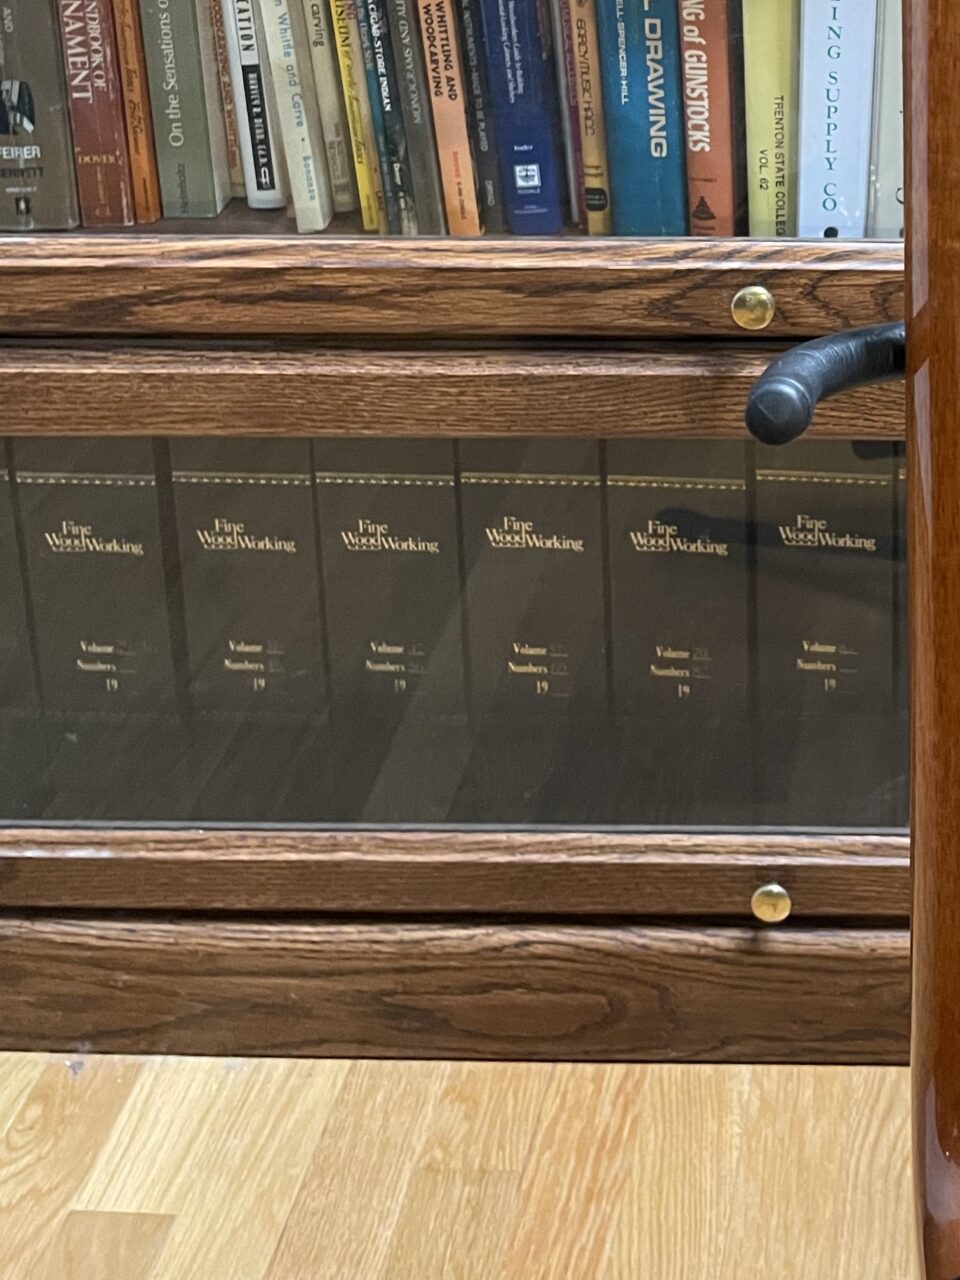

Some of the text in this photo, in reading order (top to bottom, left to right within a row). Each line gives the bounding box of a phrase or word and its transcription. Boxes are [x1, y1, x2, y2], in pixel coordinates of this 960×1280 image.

[277, 13, 293, 58] Whittle
[310, 3, 325, 47] carving
[399, 20, 412, 45] AND
[683, 25, 706, 44] of
[158, 11, 180, 91] Sensations
[422, 3, 443, 97] WOODCARVING
[434, 0, 458, 101] WHITTLING AND
[93, 69, 107, 92] OF
[286, 64, 299, 87] and
[404, 47, 422, 124] MONOGRAMS
[644, 18, 668, 158] DRAWING
[164, 95, 181, 119] the
[292, 92, 305, 127] Carve
[685, 51, 711, 153] GUNSTOCKS
[169, 122, 184, 147] On
[774, 95, 785, 149] TRENTON
[825, 71, 841, 170] SUPPLY
[78, 154, 116, 165] DOVER
[759, 149, 769, 191] VOL. 62
[775, 152, 786, 189] STATE
[822, 183, 838, 211] CO
[62, 521, 92, 536] Fine
[504, 517, 532, 532] Fine
[648, 520, 677, 537] Fine
